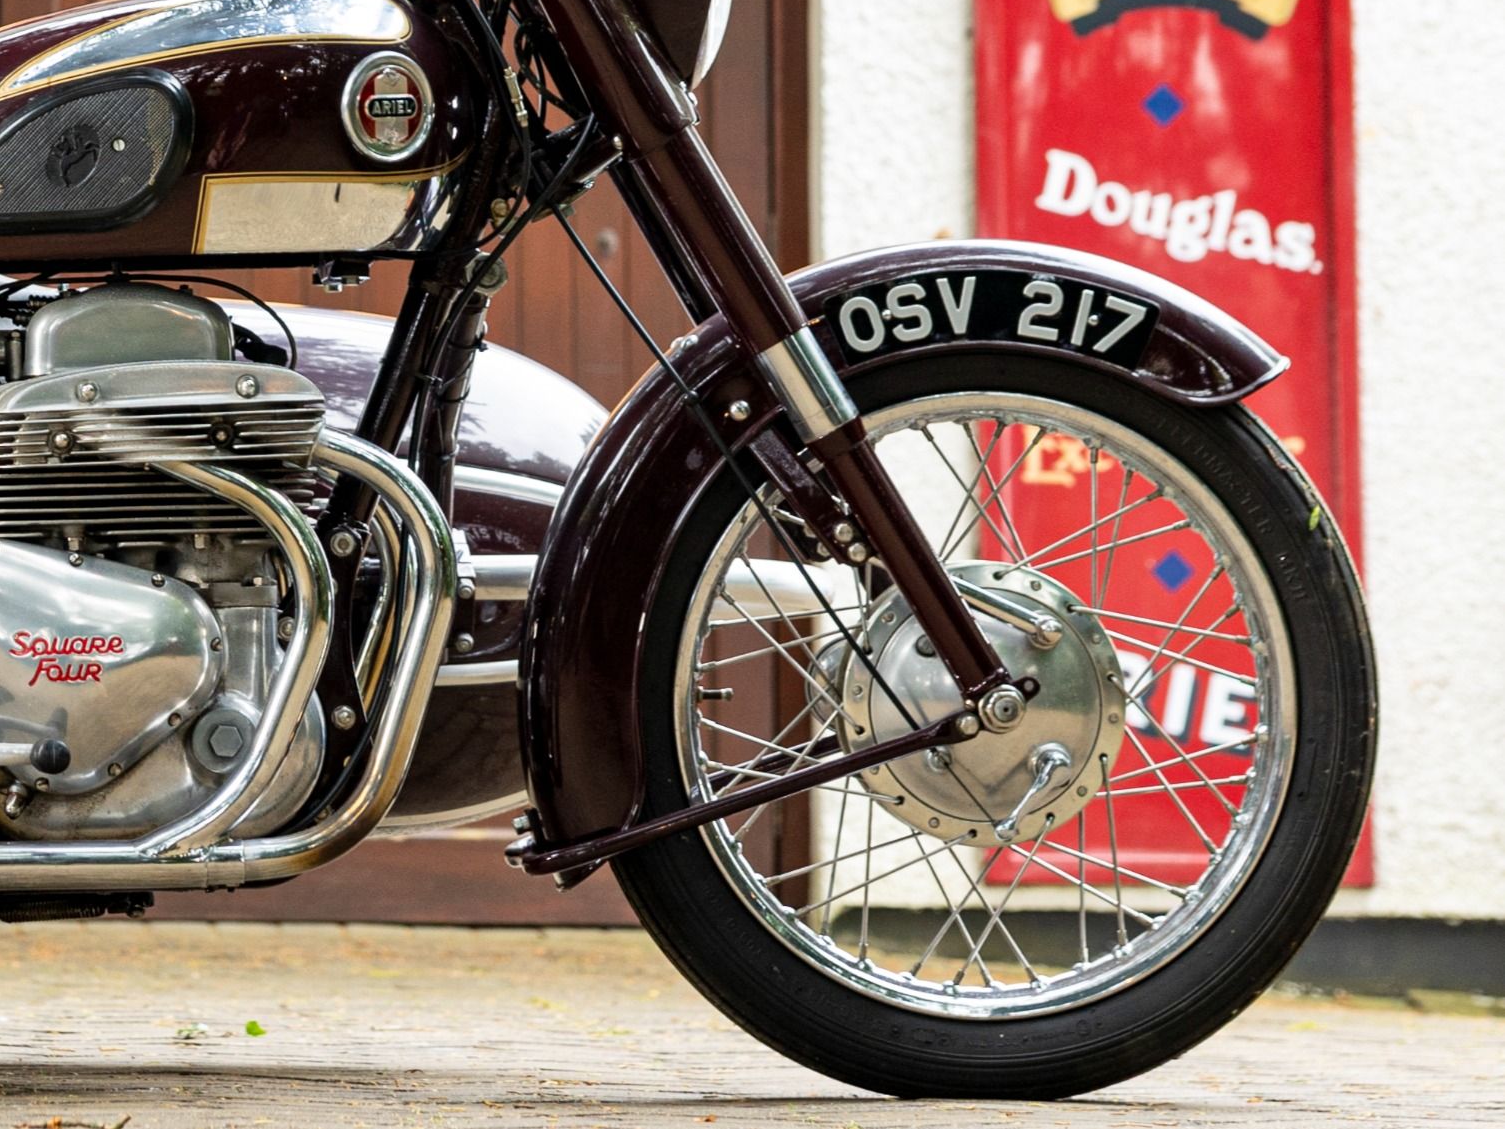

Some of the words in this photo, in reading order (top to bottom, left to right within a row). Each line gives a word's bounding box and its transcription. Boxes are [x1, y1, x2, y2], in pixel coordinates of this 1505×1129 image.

[371, 99, 413, 116] ARIEL
[838, 275, 977, 354] OSV
[1016, 280, 1148, 354] 217
